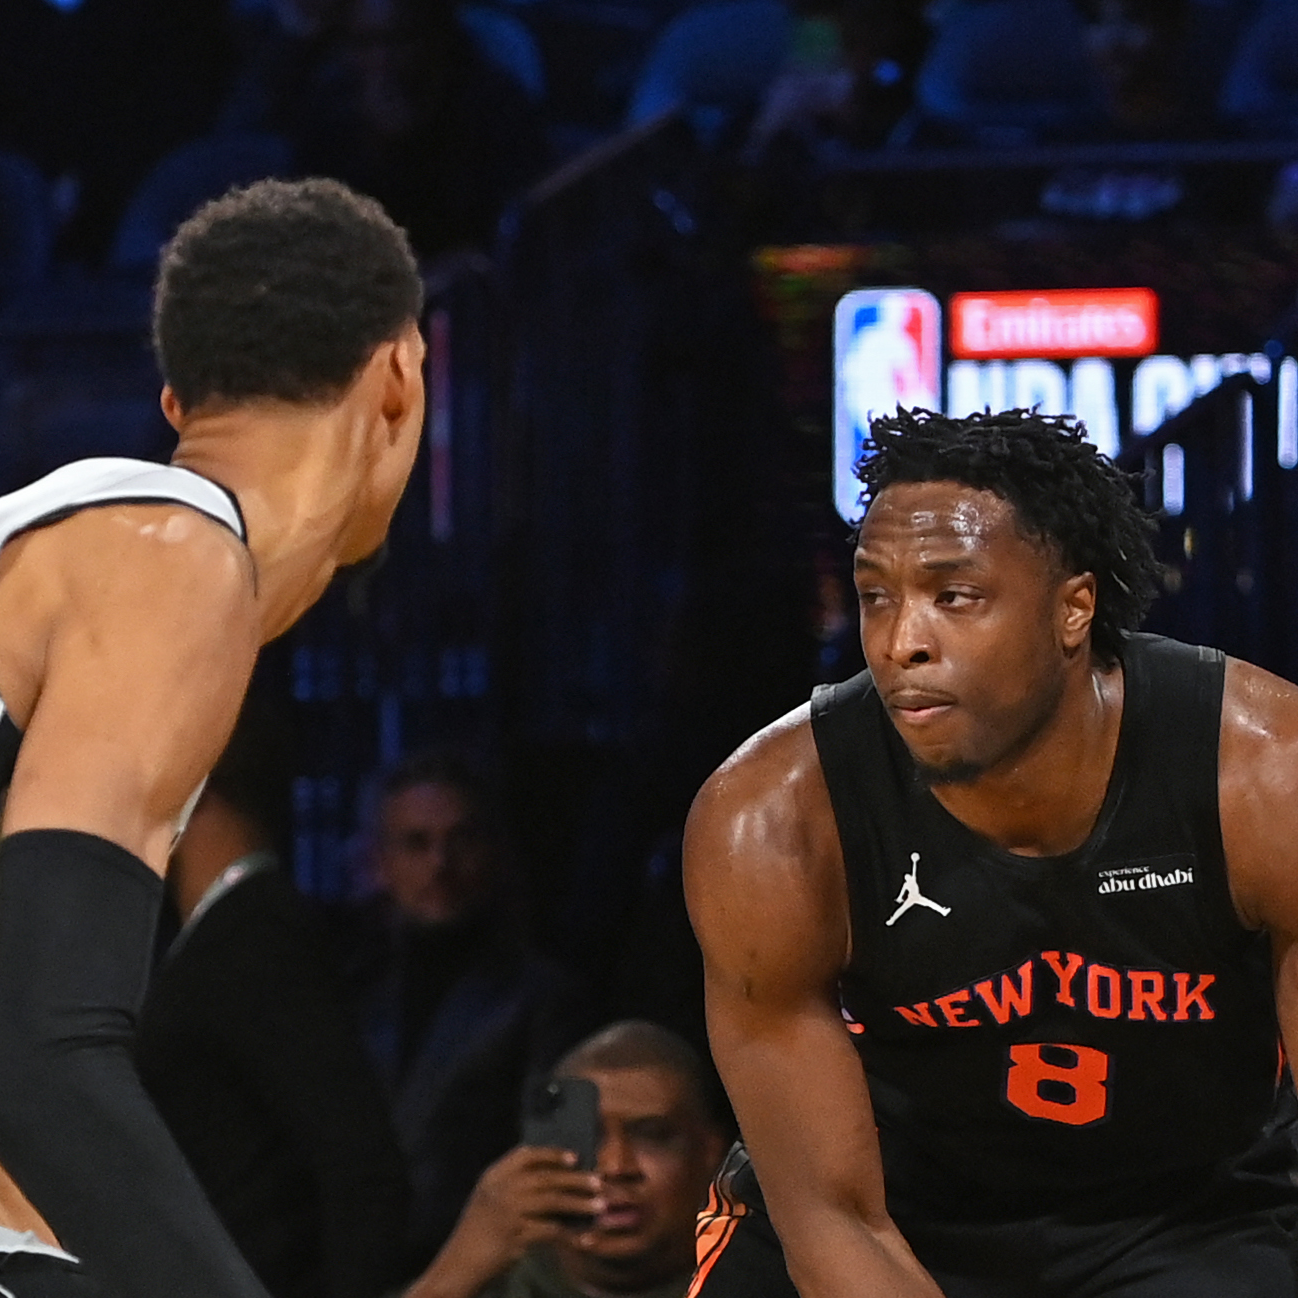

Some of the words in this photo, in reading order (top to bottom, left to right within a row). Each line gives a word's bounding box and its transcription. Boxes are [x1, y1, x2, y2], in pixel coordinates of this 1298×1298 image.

[1098, 865, 1150, 879] experience
[1098, 877, 1136, 894] abu
[1137, 867, 1194, 890] dhabi
[892, 959, 1033, 1028] NEW
[1040, 949, 1216, 1022] YORK
[1006, 1042, 1109, 1126] 8
